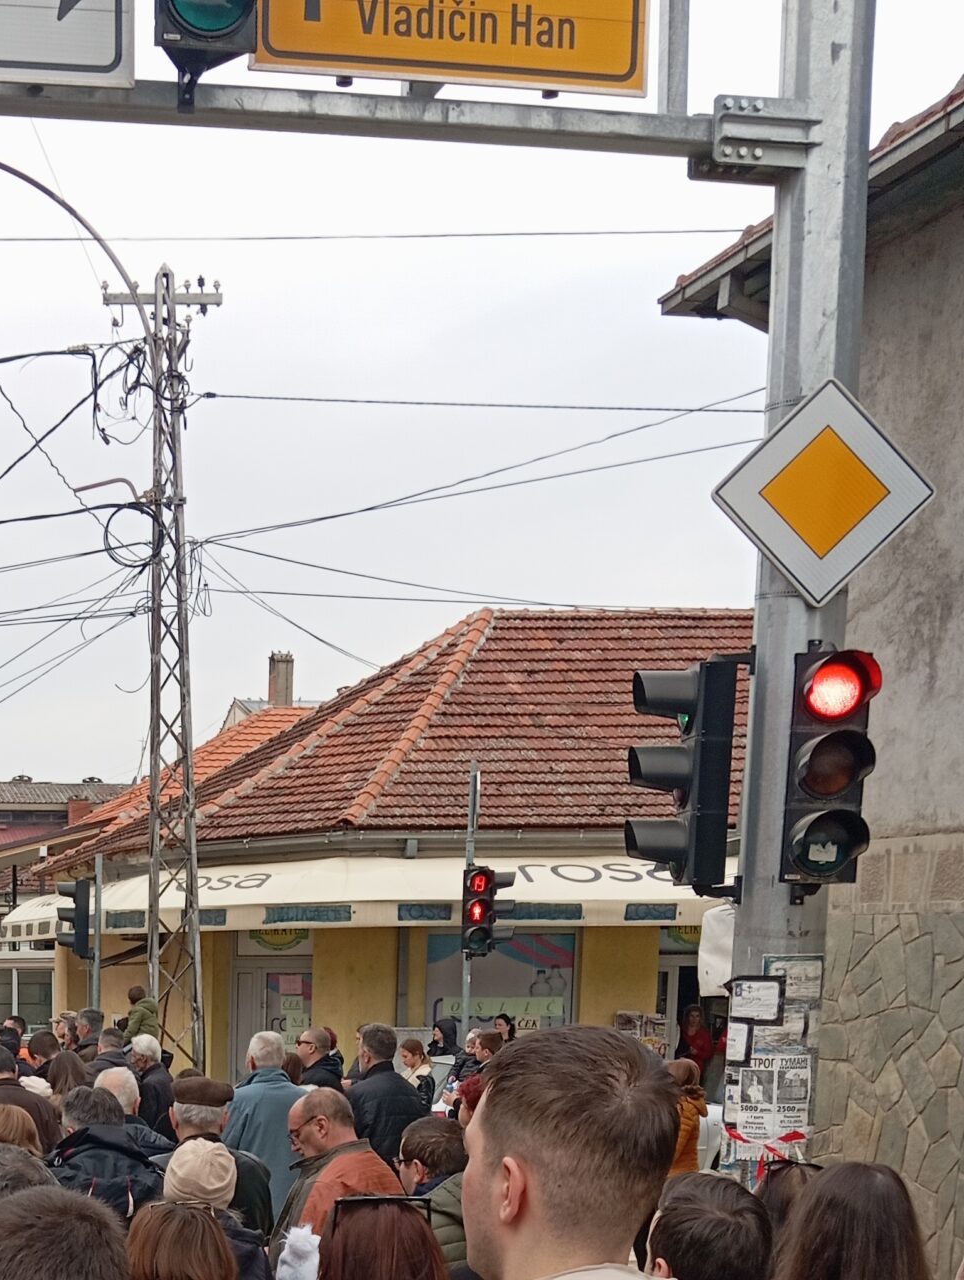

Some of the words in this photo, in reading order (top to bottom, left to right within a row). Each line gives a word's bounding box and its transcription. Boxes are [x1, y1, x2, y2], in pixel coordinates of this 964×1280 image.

[358, 0, 498, 44] Vladičin
[511, 3, 575, 49] Han
[517, 1017, 538, 1029] ČEK
[740, 1104, 758, 1112] 5000
[776, 1105, 796, 1113] 2500
